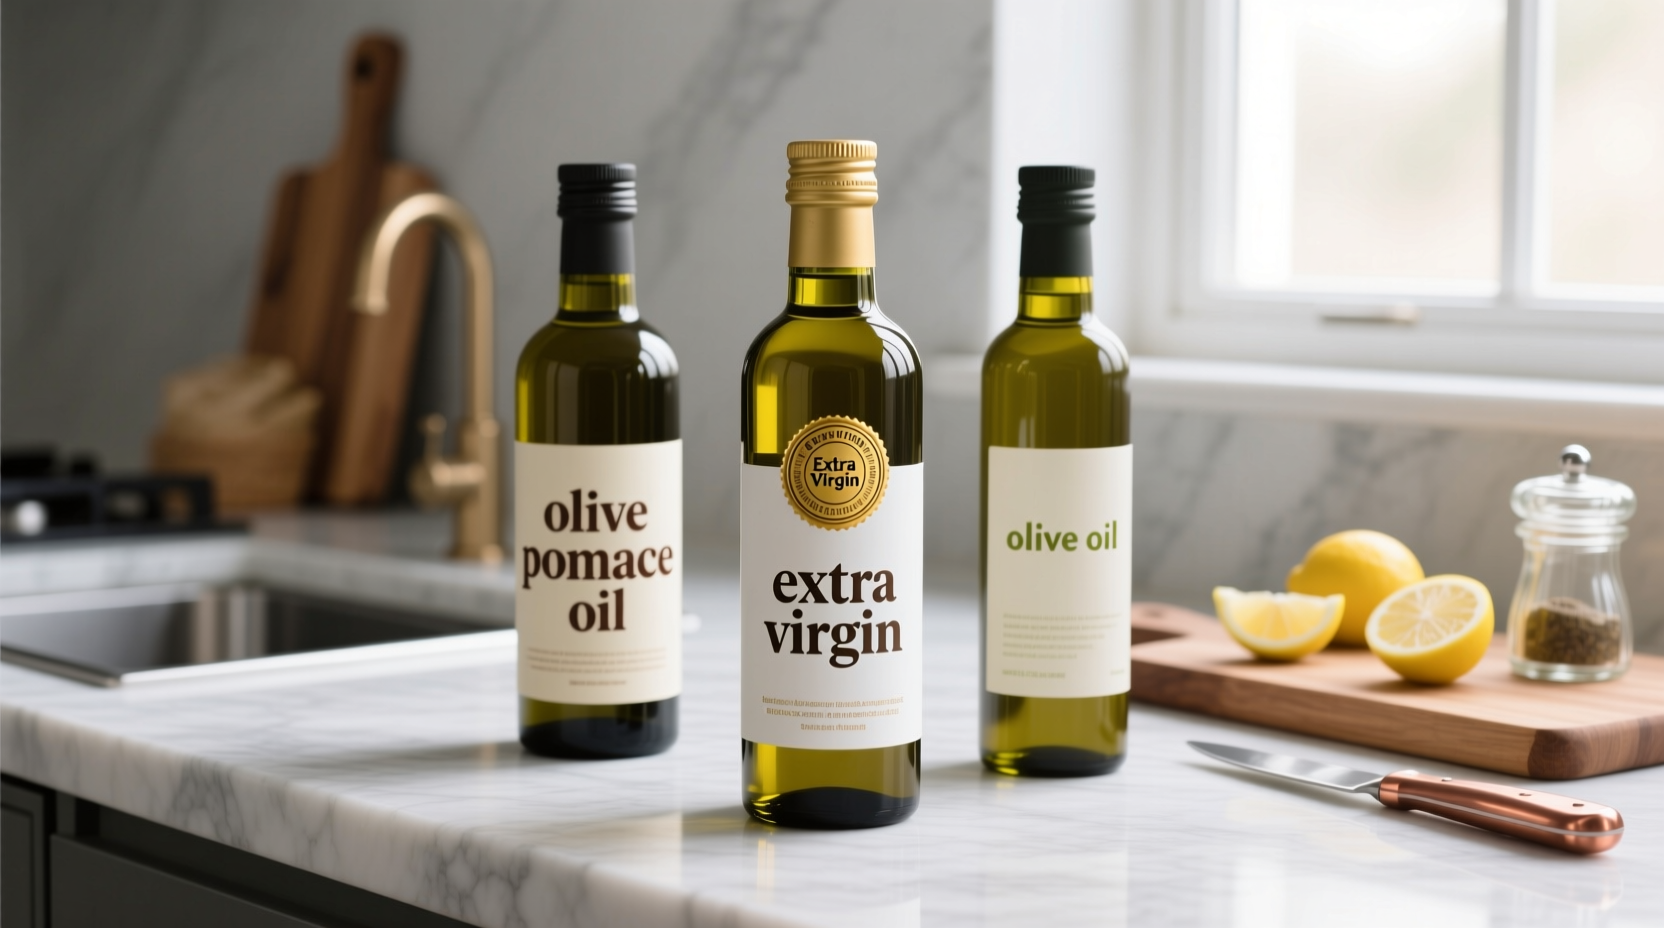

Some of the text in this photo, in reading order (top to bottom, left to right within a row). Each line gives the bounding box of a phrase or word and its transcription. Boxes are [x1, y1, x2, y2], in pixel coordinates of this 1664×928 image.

[813, 457, 856, 472] Extra
[544, 488, 648, 533] olive
[1006, 520, 1117, 551] olive oil
[522, 546, 673, 589] pomace
[773, 563, 897, 604] extra
[568, 588, 626, 632] oil
[764, 608, 903, 668] virgin
